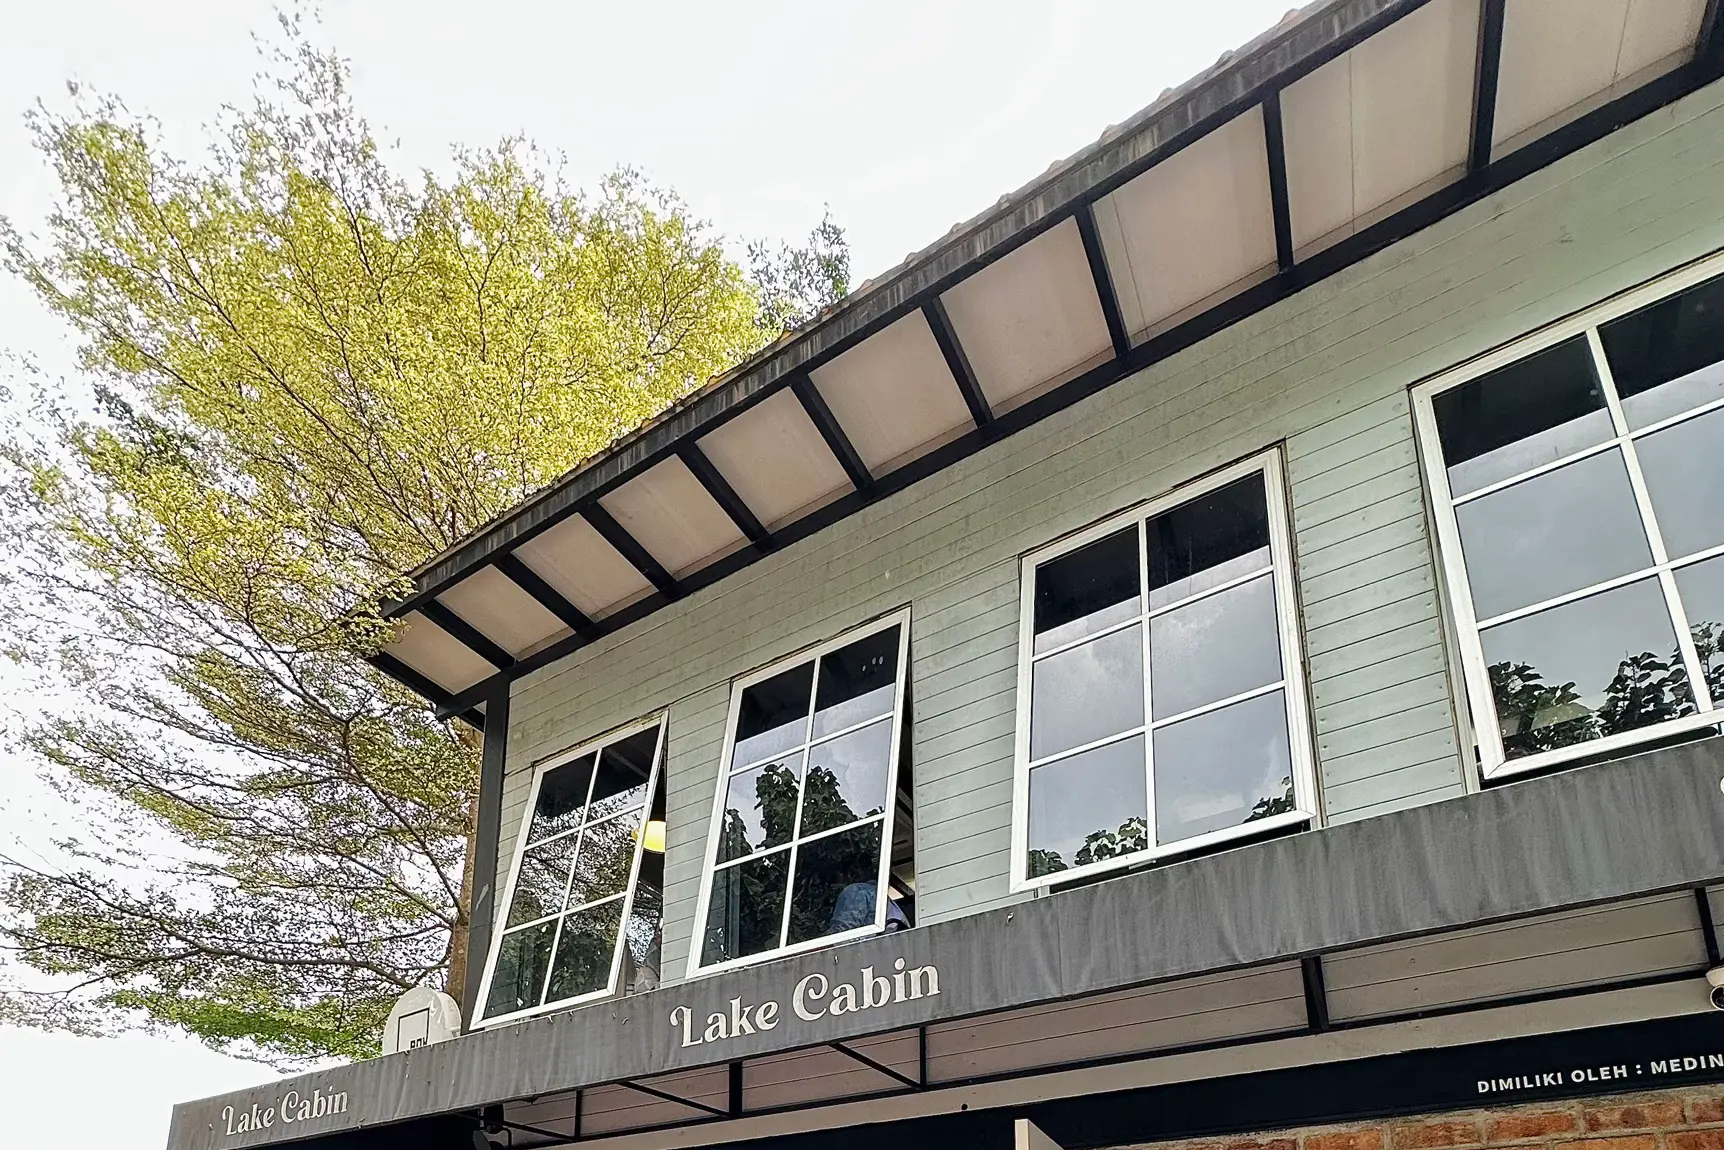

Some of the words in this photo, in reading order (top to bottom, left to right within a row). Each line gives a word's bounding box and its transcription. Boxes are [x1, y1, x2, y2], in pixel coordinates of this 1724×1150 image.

[669, 996, 780, 1048] Lake
[792, 957, 941, 1021] Cabin
[1477, 1072, 1563, 1093] DIMILIKI
[1571, 1064, 1628, 1083] OLEH
[1650, 1053, 1724, 1075] MEDIN
[222, 1105, 275, 1136] Lake
[281, 1085, 348, 1123] Cabin
